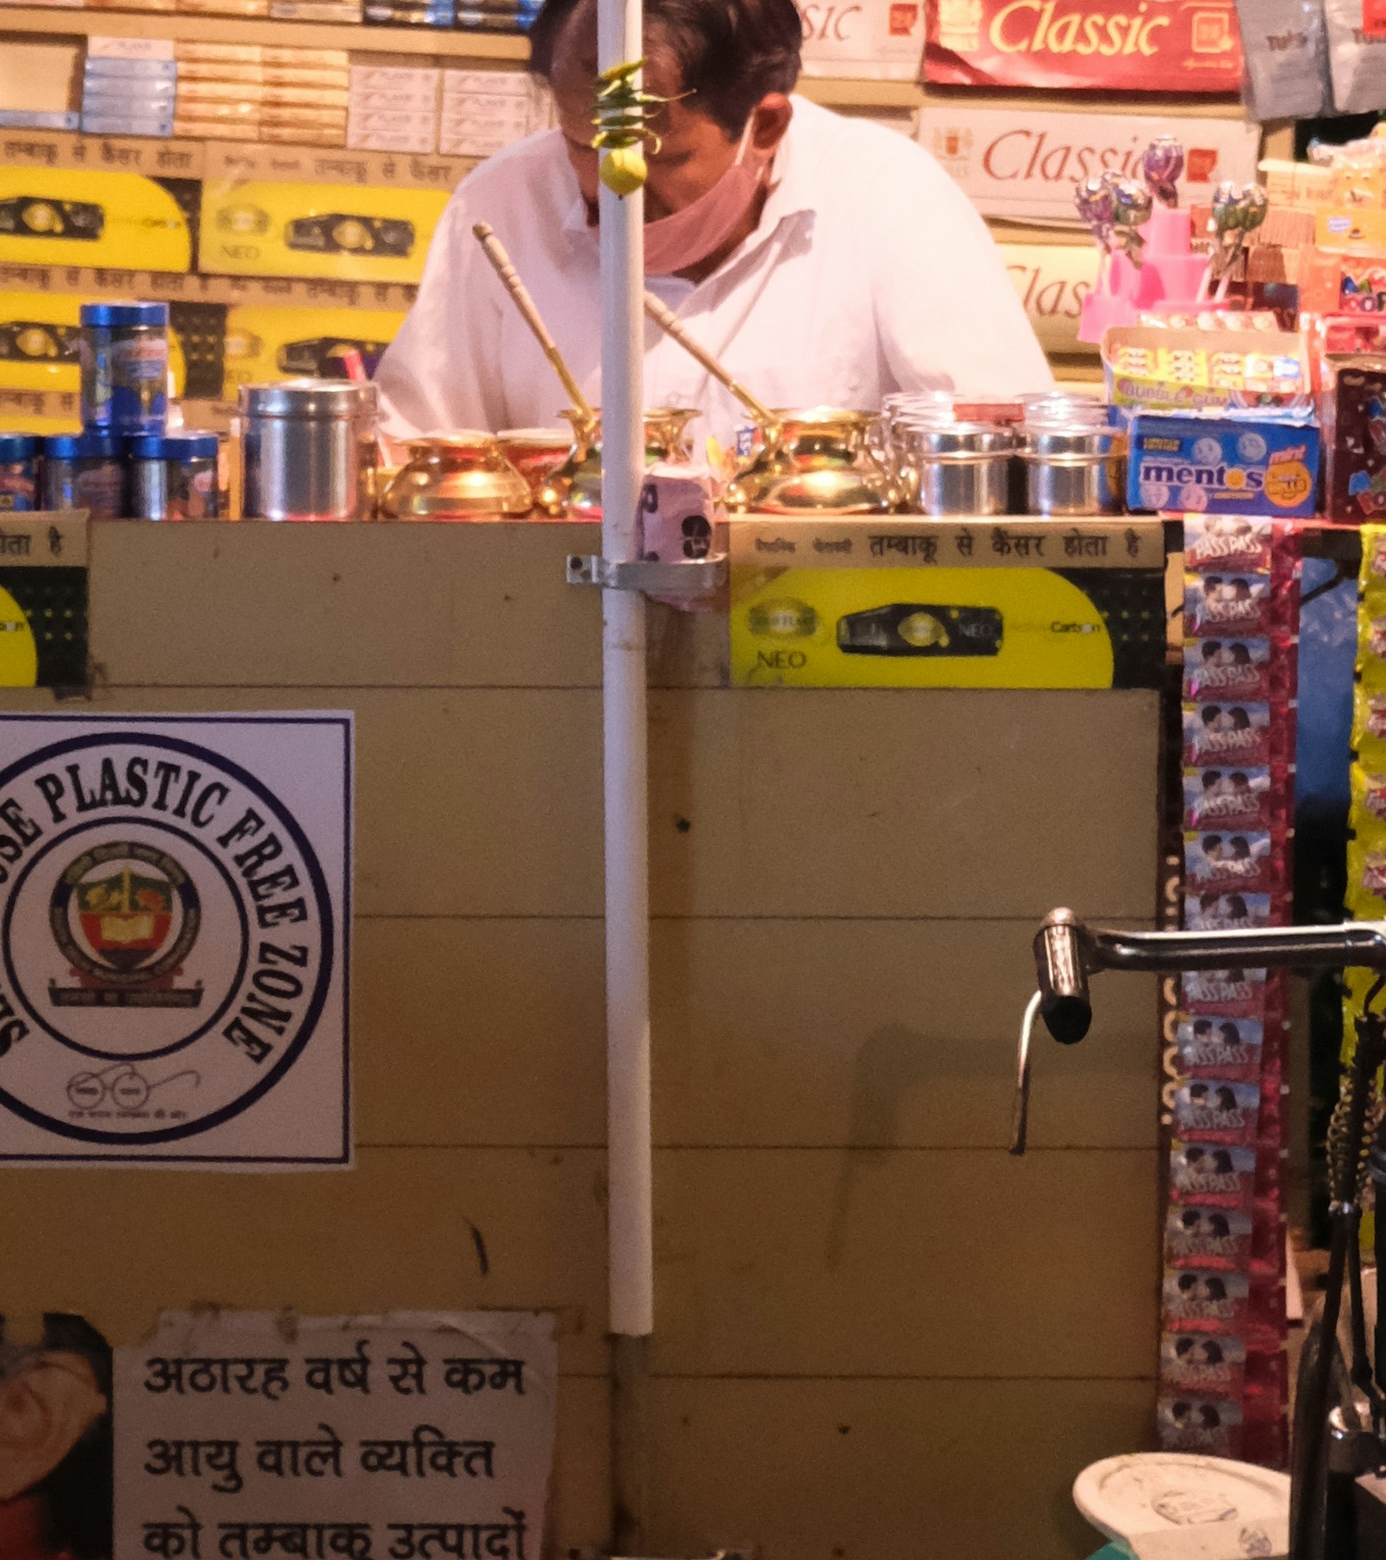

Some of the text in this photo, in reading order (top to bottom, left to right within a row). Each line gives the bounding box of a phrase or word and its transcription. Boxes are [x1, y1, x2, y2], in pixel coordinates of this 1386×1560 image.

[1141, 464, 1265, 490] mentos
[49, 526, 66, 557] है
[868, 533, 937, 565] तम्बाकू
[955, 531, 974, 557] से
[992, 532, 1045, 559] कैंसर
[1063, 533, 1107, 559] होता
[1122, 532, 1141, 559] है
[1196, 534, 1263, 560] PASS PASS
[756, 651, 807, 669] NEO
[35, 756, 230, 829] PLASTIC
[217, 807, 308, 929] FREE
[223, 941, 308, 1064] ZONE
[144, 1341, 526, 1398] अठारह वर्ष से कम
[144, 1423, 495, 1492] आयु वाले व्यक्ति
